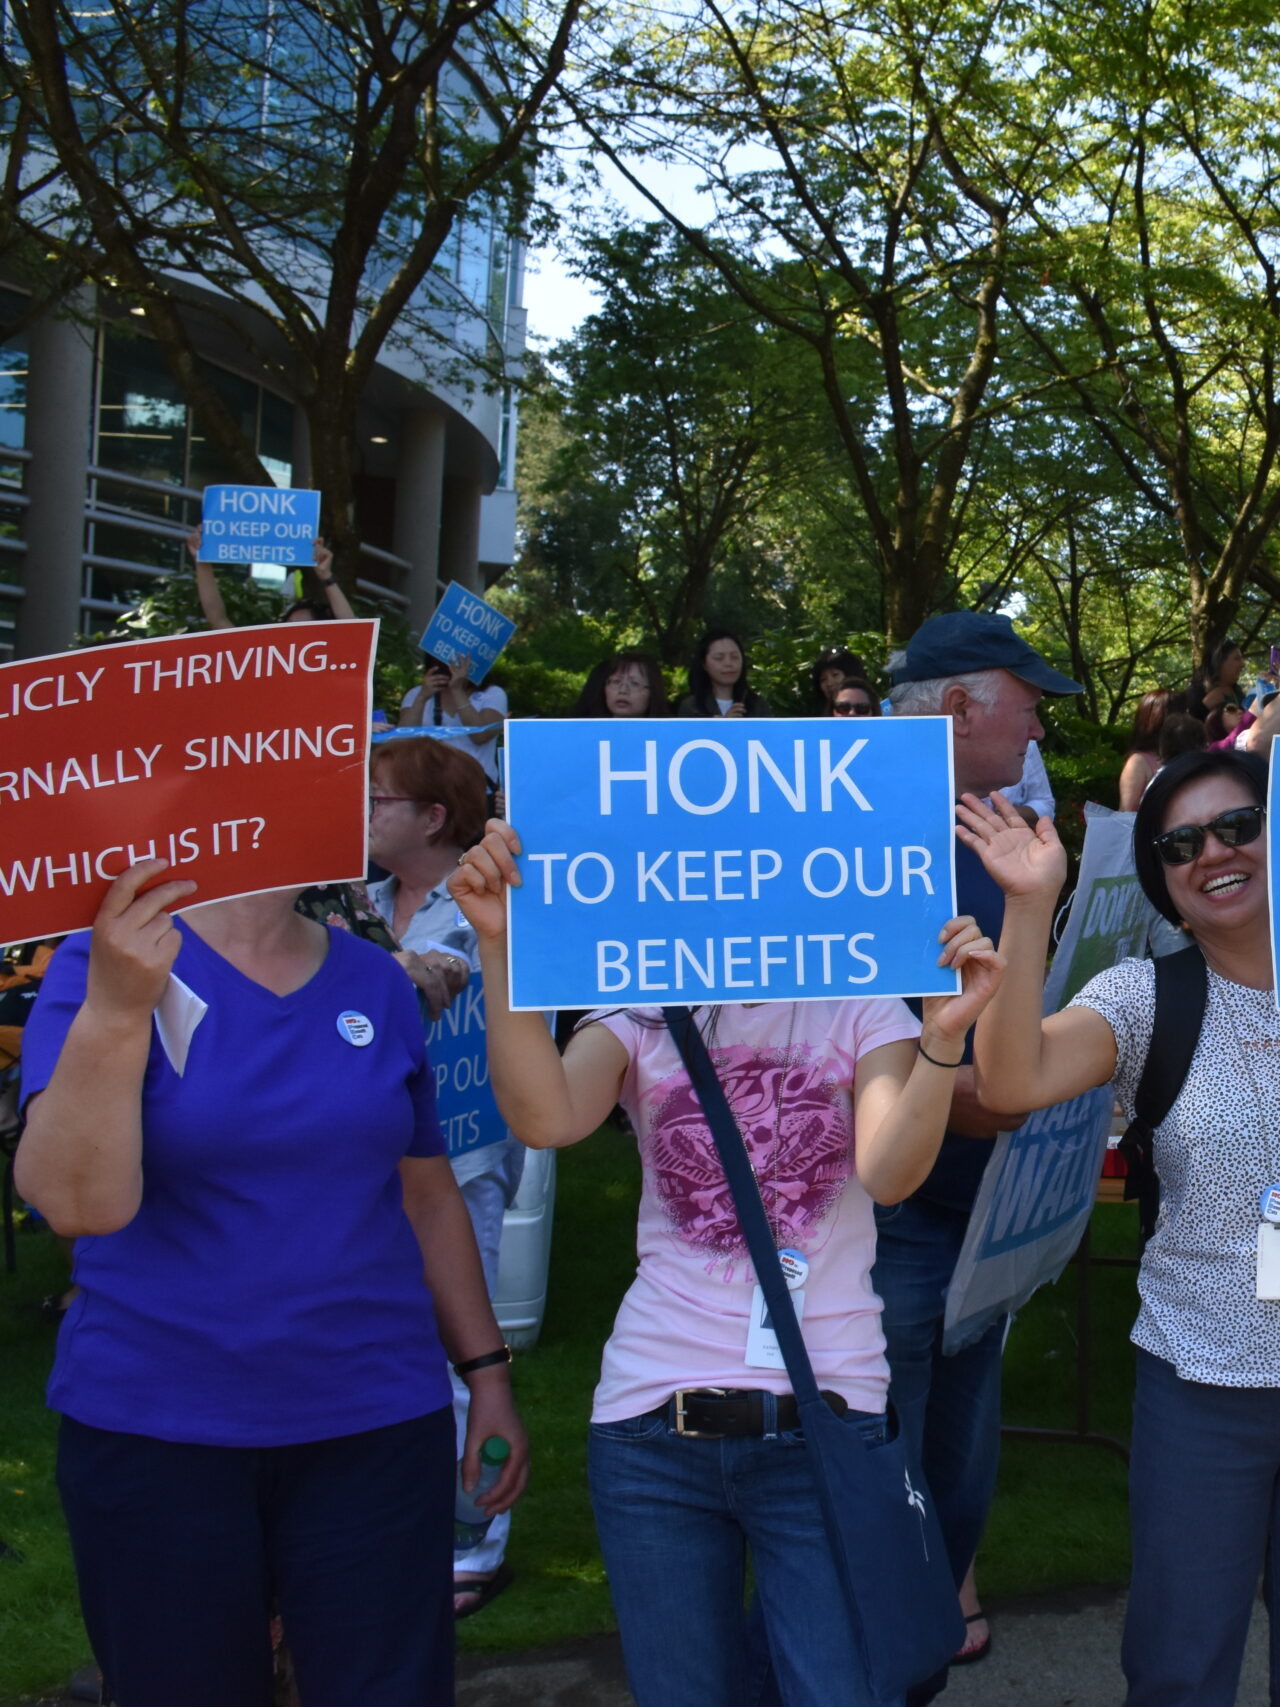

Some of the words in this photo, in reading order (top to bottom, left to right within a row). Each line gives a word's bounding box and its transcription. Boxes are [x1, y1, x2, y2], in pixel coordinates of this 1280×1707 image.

[220, 490, 296, 515] HONK
[203, 519, 226, 536] TO
[229, 521, 271, 537] KEEP
[274, 523, 313, 539] OUR
[218, 544, 296, 561] BENEFITS
[436, 612, 453, 633] TO
[451, 625, 481, 649] KEEP
[456, 596, 504, 640] HONK
[124, 641, 358, 694] THRIVING...
[184, 724, 355, 772] SINKING
[598, 738, 874, 815] HONK
[0, 838, 157, 896] WHICH
[169, 827, 200, 867] IS
[212, 817, 266, 855] IT?
[528, 852, 615, 904] TO
[637, 849, 783, 902] KEEP
[802, 845, 935, 898] OUR
[597, 932, 878, 992] BENEFITS
